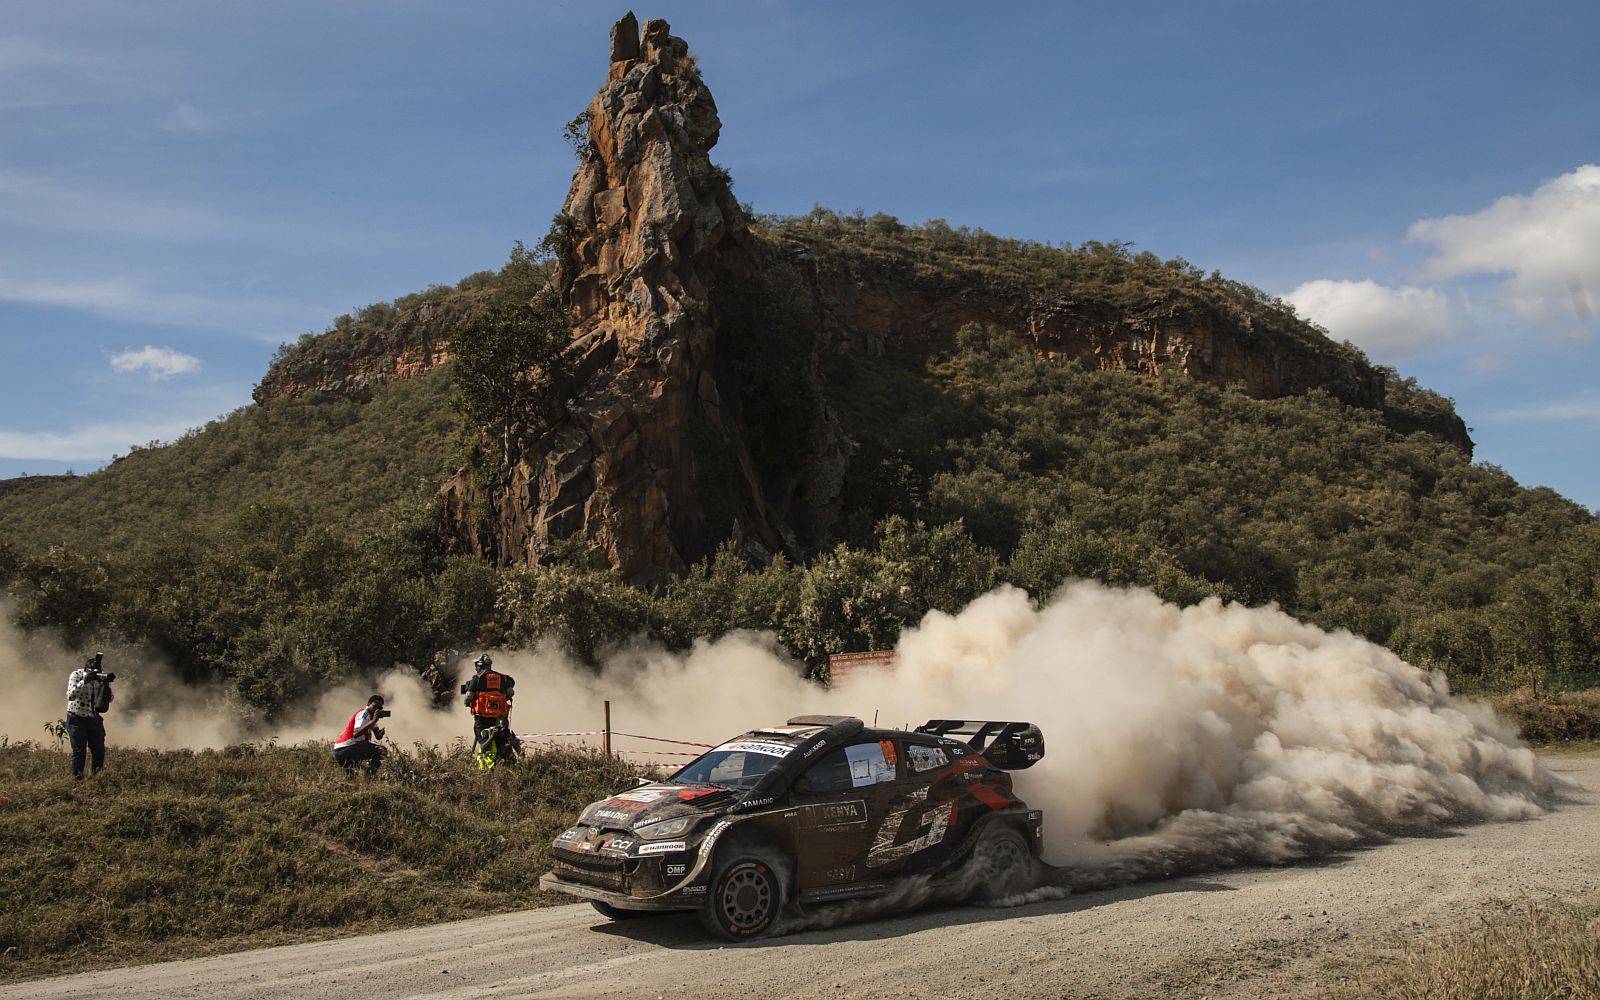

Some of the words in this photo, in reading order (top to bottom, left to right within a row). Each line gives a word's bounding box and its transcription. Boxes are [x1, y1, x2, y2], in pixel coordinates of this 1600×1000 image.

[879, 740, 897, 765] 18
[742, 797, 774, 808] TAMADIC
[595, 810, 629, 820] TAMADIC
[823, 804, 858, 819] KENYA
[611, 839, 634, 850] CCI
[667, 866, 686, 874] OMP
